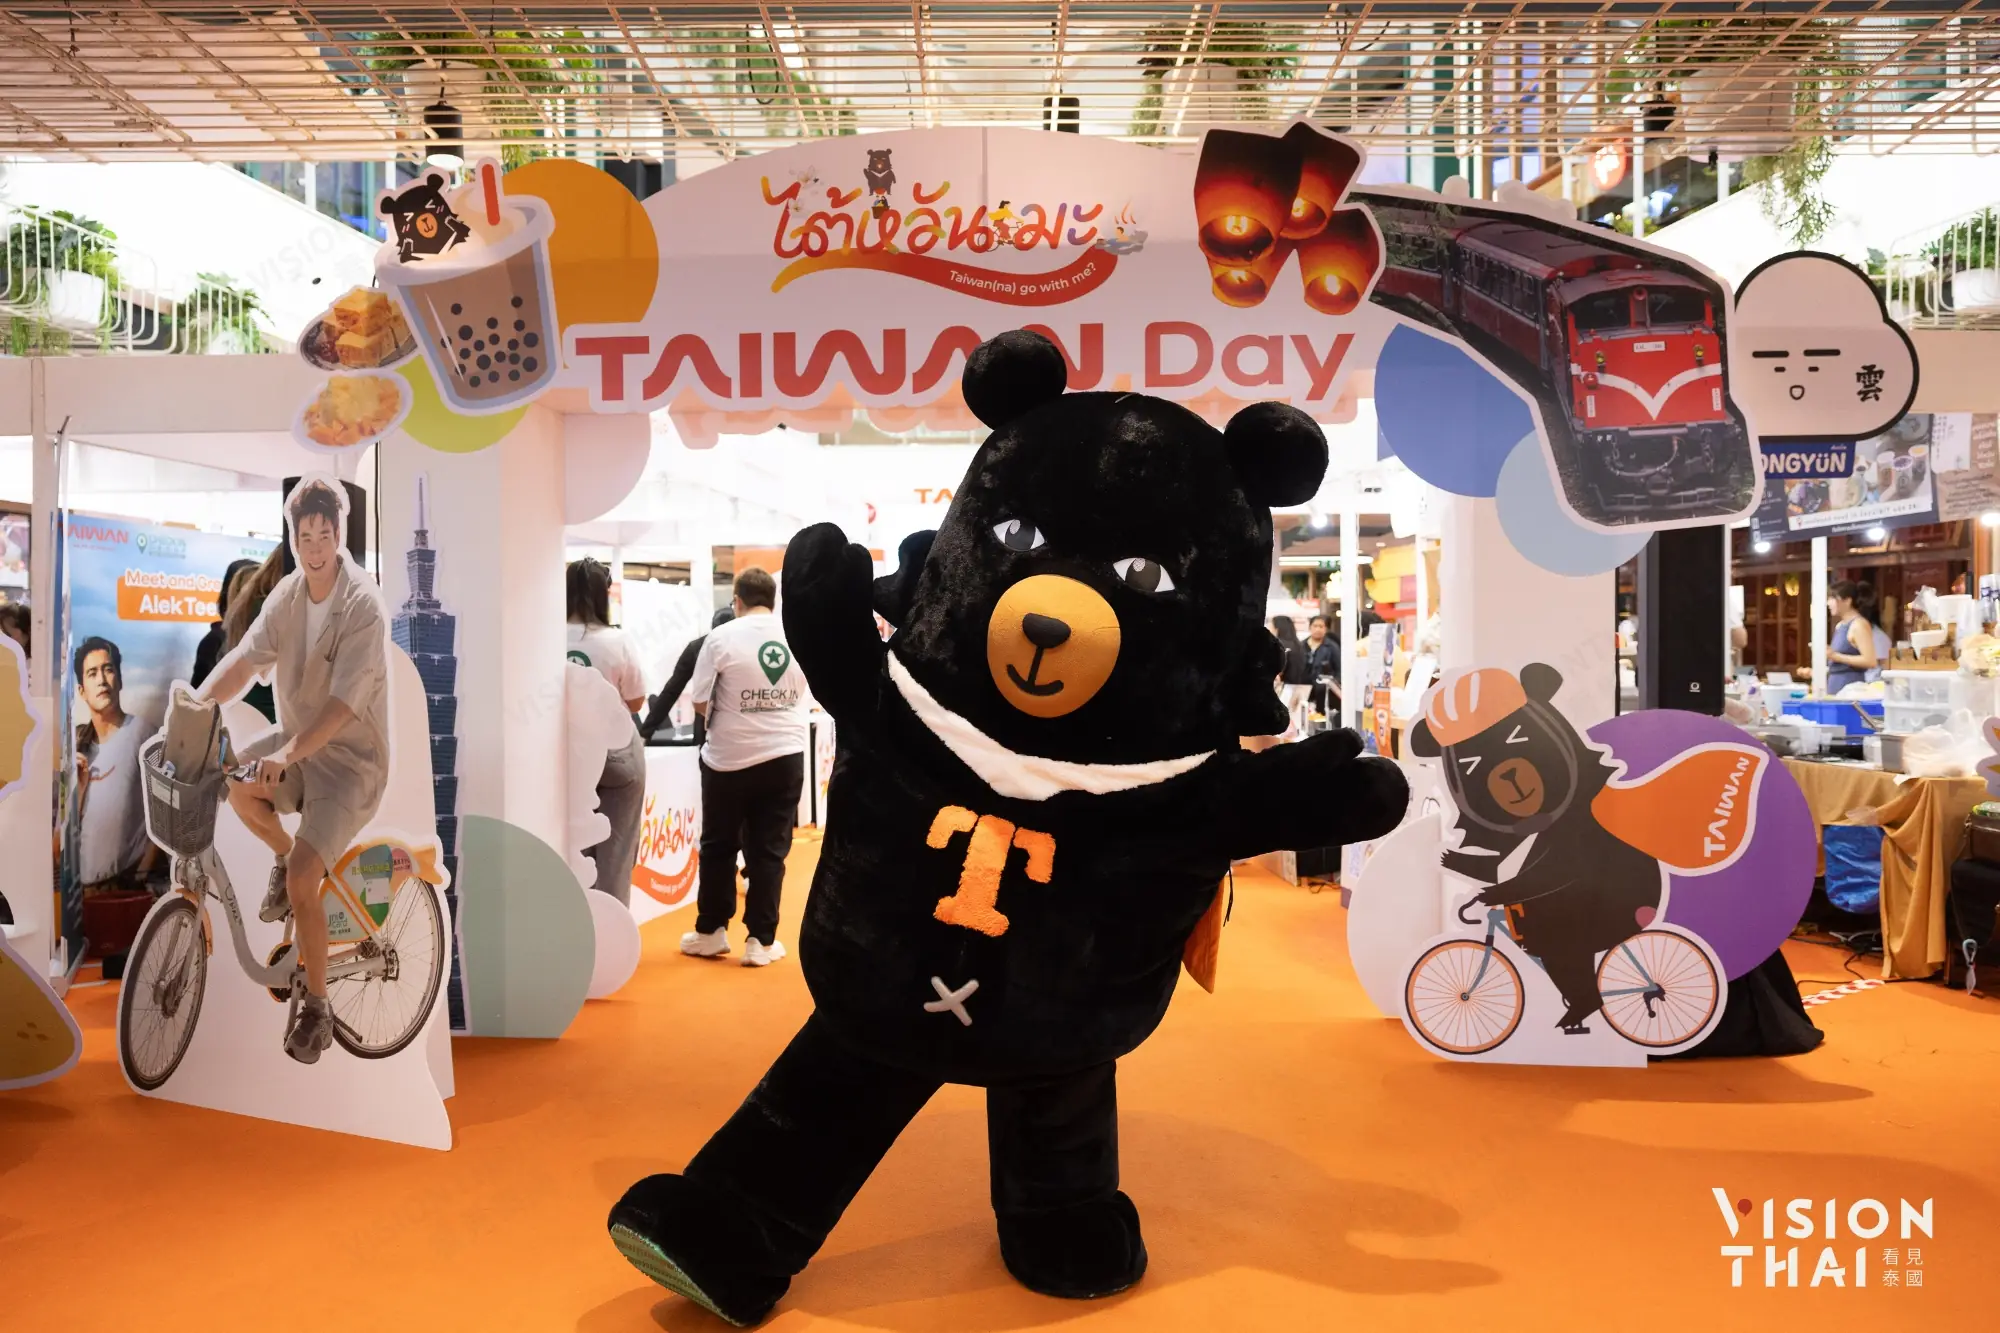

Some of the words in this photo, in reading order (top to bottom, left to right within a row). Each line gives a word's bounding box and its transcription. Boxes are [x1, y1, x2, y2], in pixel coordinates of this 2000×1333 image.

[949, 270, 1017, 295] Taiwan(na)
[1020, 284, 1037, 296] go
[1040, 278, 1069, 293] with
[1072, 262, 1097, 285] me?
[1145, 321, 1356, 401] Day
[1855, 363, 1886, 402] 雲
[127, 570, 165, 587] Meet
[168, 573, 194, 588] and
[140, 594, 183, 615] Alek
[184, 597, 219, 616] Tee
[740, 688, 787, 701] CHECK
[1703, 756, 1750, 858] TAIWAN
[926, 805, 1057, 938] T
